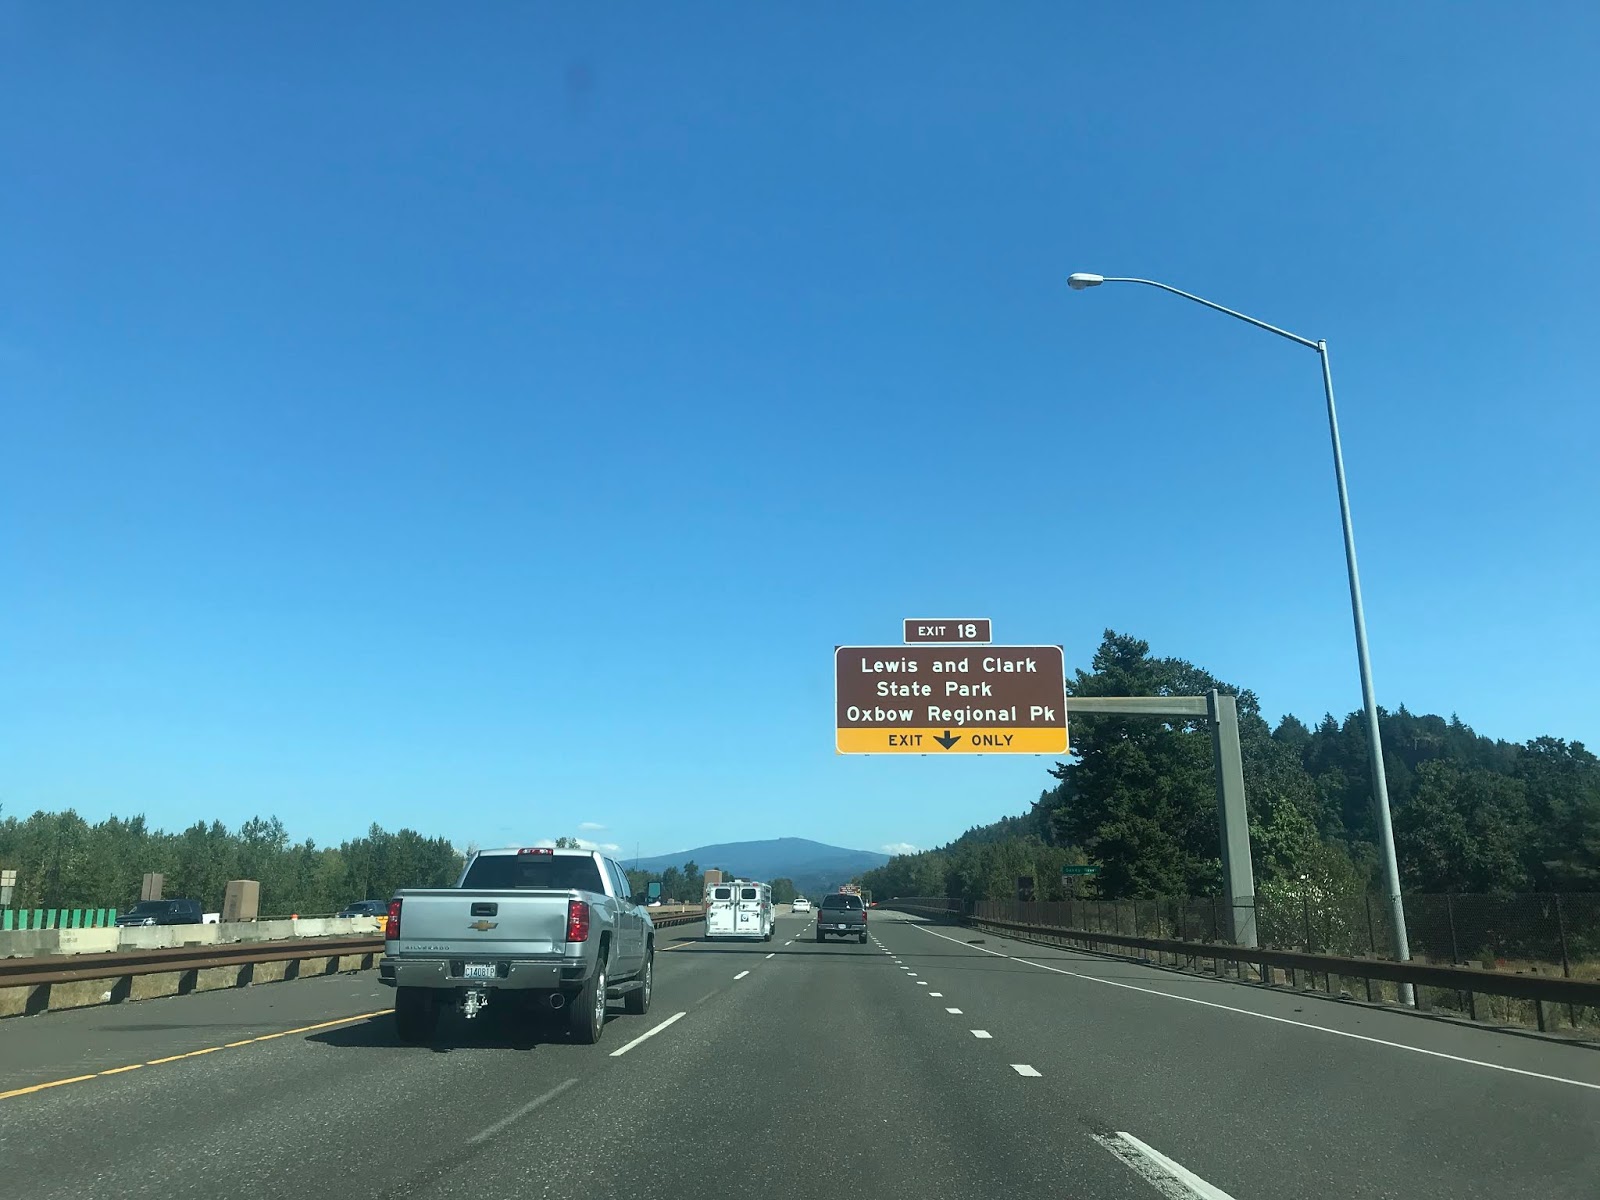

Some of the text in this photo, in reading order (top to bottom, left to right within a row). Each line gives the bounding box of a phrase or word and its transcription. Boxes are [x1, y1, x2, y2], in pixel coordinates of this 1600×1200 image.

[919, 624, 977, 638] EXIT 18
[861, 657, 1037, 673] Lewis and Clark
[876, 681, 992, 697] State Park
[846, 706, 1056, 726] Oxbow Regional Pk
[889, 734, 1013, 746] EXIT ONLY
